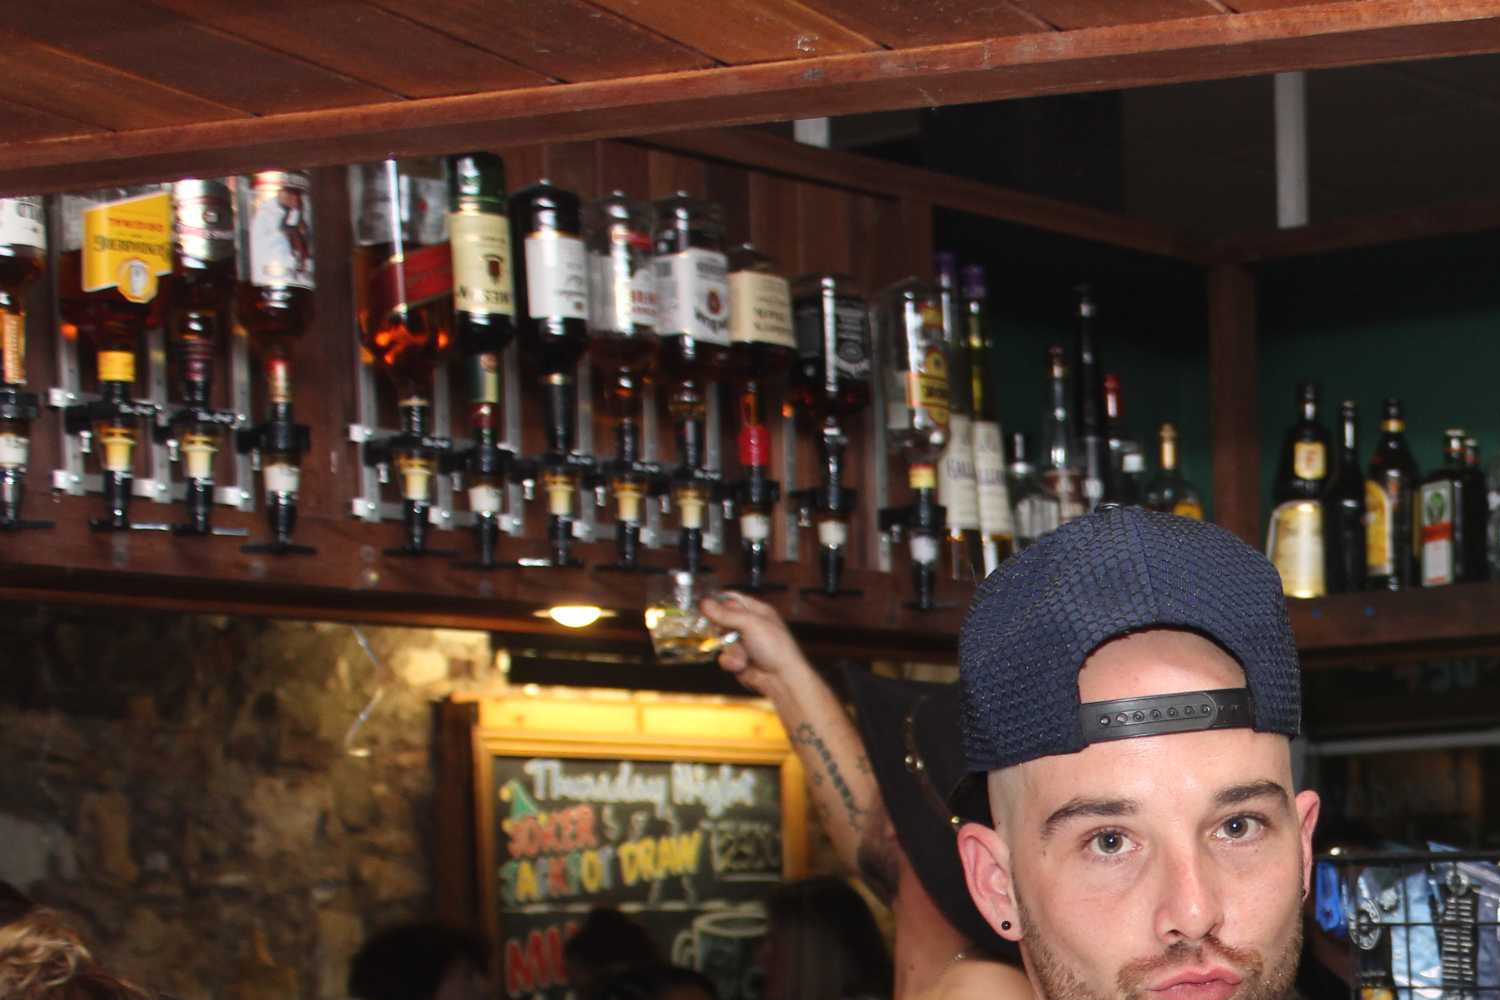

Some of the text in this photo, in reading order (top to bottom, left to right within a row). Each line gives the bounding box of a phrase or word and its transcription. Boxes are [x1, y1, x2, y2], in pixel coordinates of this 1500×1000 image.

[524, 760, 669, 814] Thursday
[671, 763, 756, 815] Night
[506, 804, 596, 857] JOKER
[617, 830, 704, 886] DRAW
